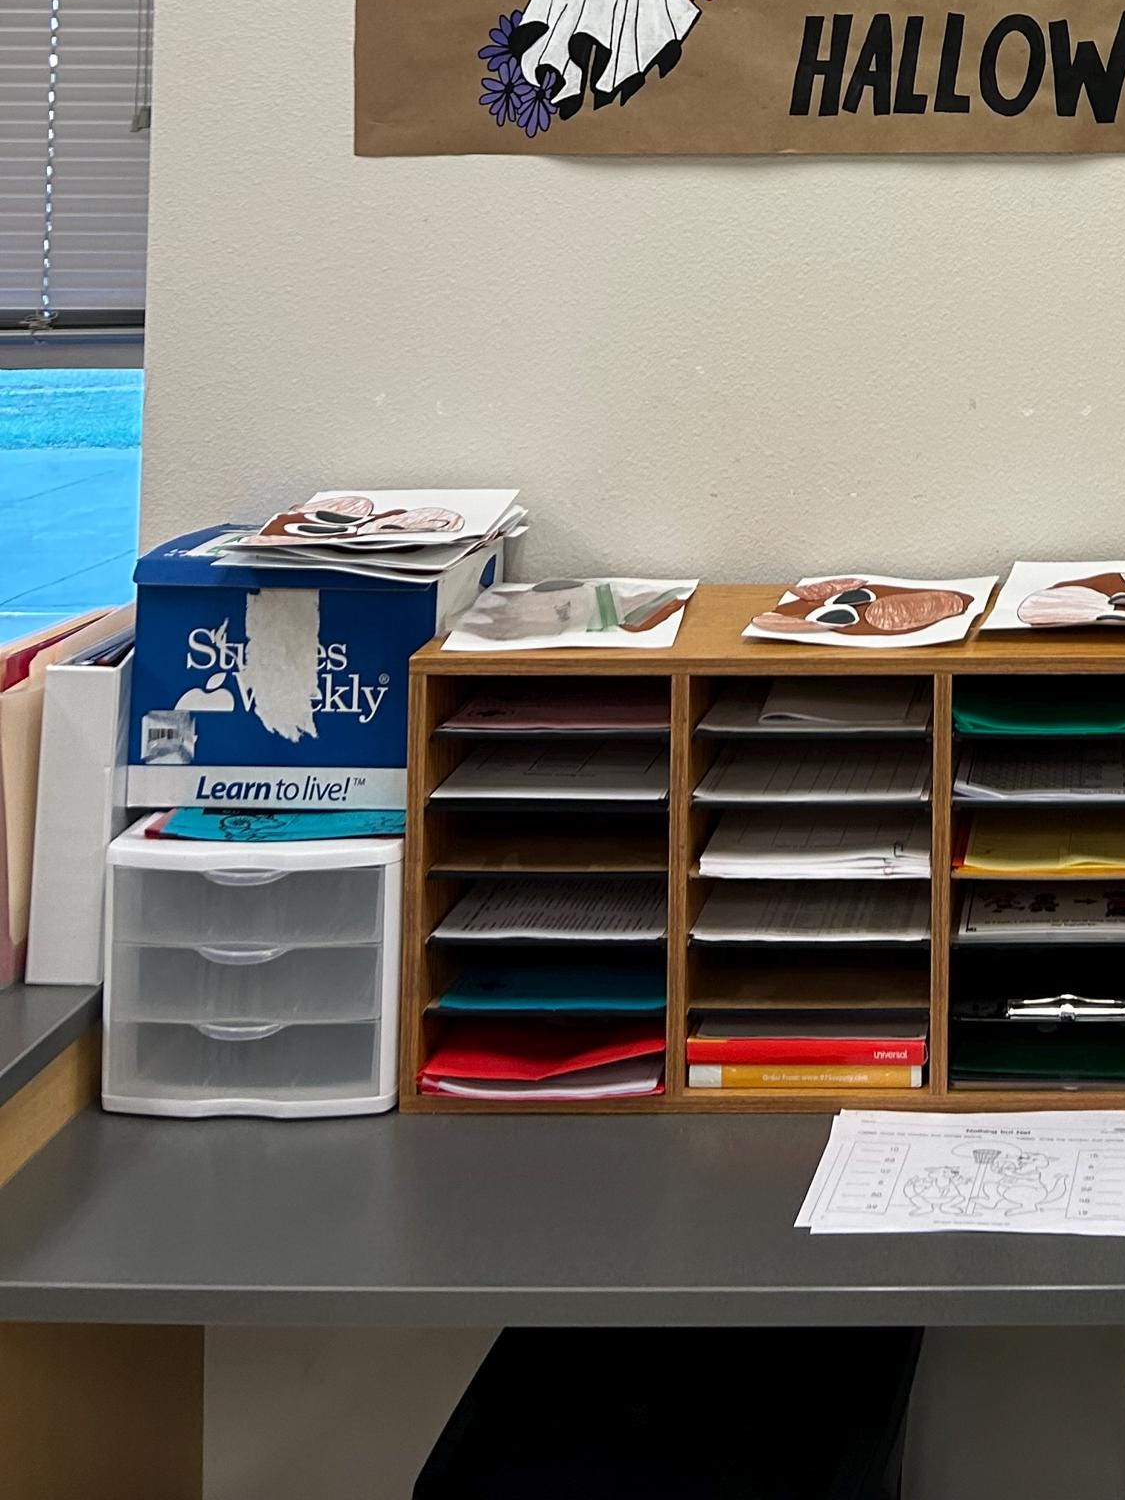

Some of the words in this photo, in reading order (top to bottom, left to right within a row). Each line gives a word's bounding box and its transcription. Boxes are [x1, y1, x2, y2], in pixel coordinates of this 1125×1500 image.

[187, 626, 348, 670] Stes
[232, 669, 389, 724] Wekly
[196, 776, 271, 800] Learn
[276, 779, 299, 800] to
[873, 1050, 908, 1060] universal
